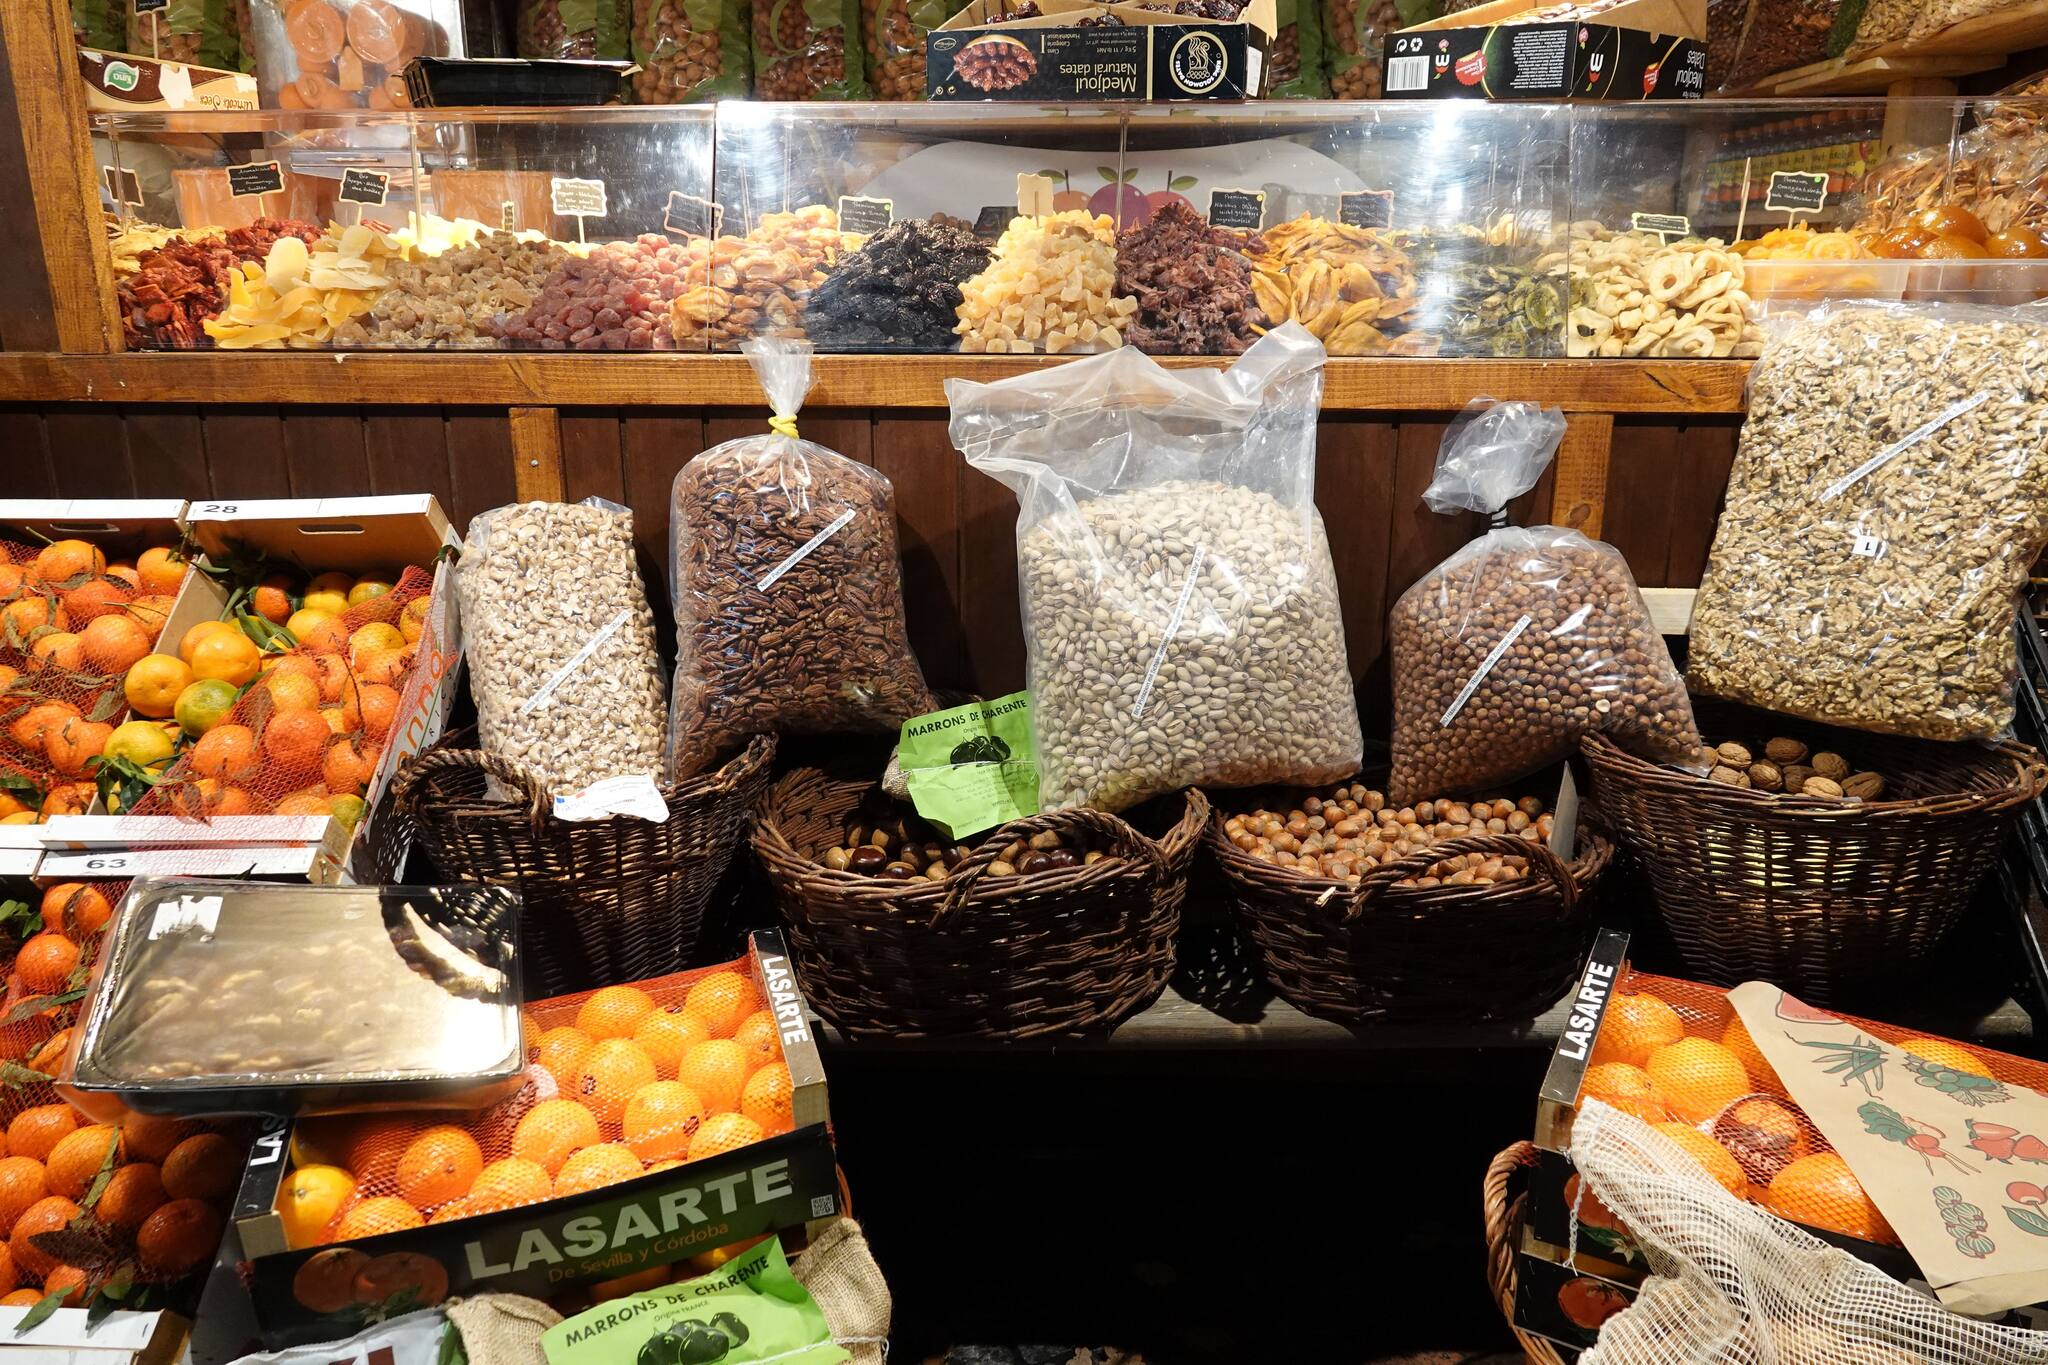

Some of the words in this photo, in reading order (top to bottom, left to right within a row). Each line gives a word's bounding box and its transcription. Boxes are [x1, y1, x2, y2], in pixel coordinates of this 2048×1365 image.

[1060, 64, 1090, 75] dates
[1094, 63, 1137, 75] Natural
[1687, 50, 1705, 69] Dates
[1176, 61, 1185, 80] DATES
[1675, 67, 1703, 89] Medjoul
[1076, 73, 1137, 93] Medjoul
[1184, 76, 1214, 87] SOLOMON
[204, 503, 238, 514] 28
[1137, 681, 1151, 705] Pistazien
[907, 715, 966, 738] MARRONS
[969, 711, 980, 722] DE
[982, 700, 1027, 720] CHARENTE
[86, 858, 126, 870] 63
[762, 955, 808, 1046] LASARTE
[1558, 961, 1614, 1062] LASARTE
[464, 1158, 793, 1280] LASARTE
[549, 1268, 575, 1283] De
[581, 1252, 633, 1275] Sevilla
[639, 1249, 650, 1263] y
[653, 1221, 729, 1254] Córdoba
[566, 1298, 658, 1347] MARRONS
[665, 1293, 687, 1305] DE
[694, 1255, 769, 1296] CHARENTE
